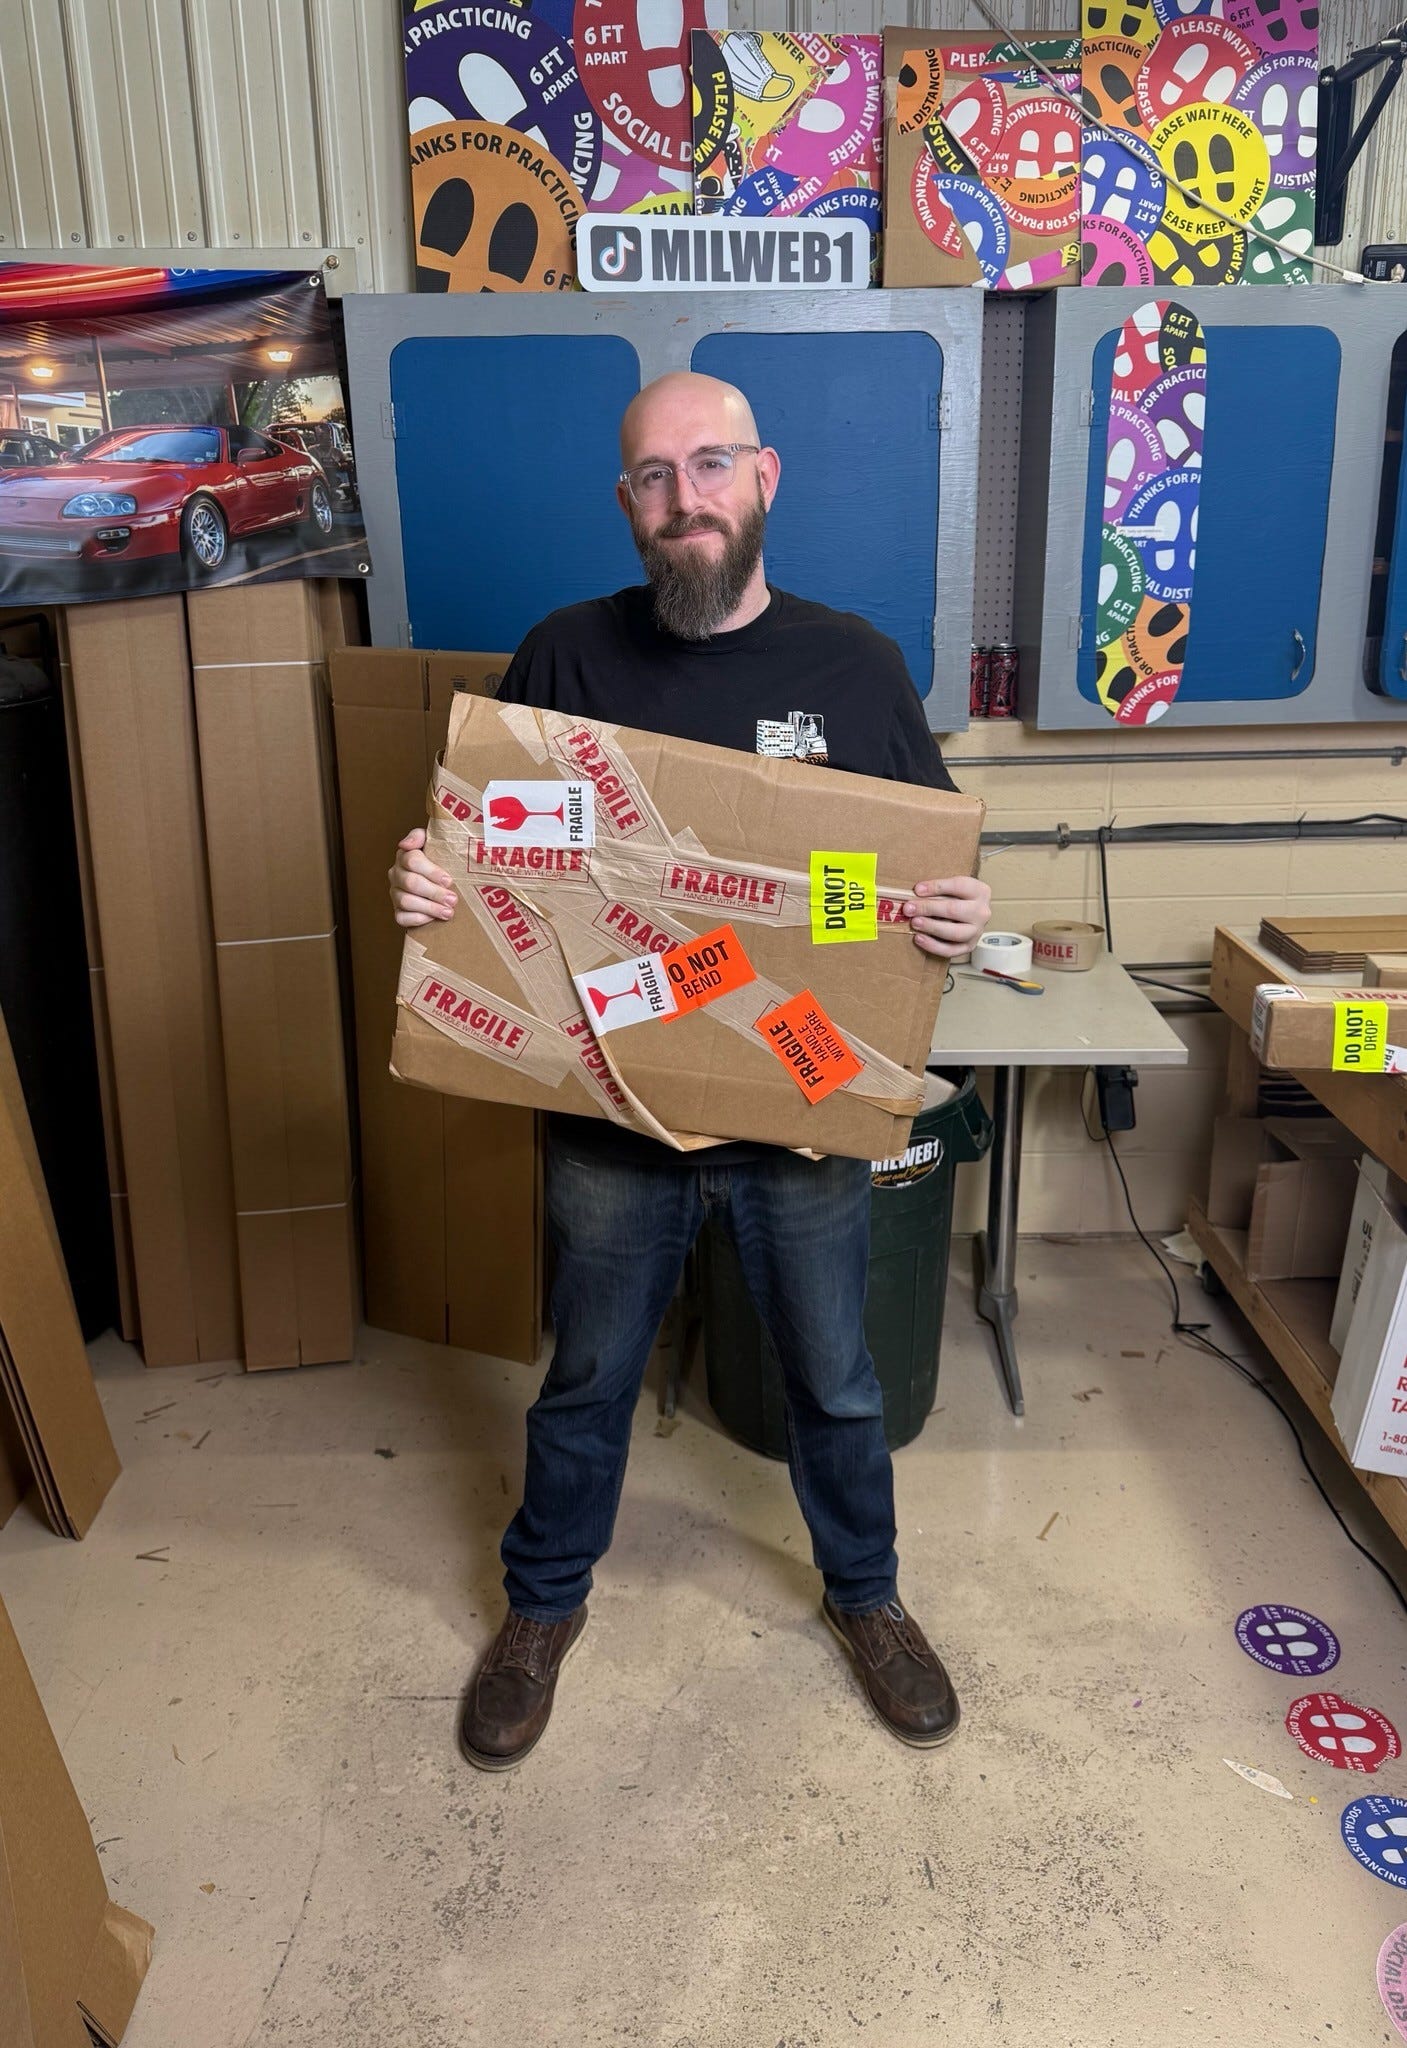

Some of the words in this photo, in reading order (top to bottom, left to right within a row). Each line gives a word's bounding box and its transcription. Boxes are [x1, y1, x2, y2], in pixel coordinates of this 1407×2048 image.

[408, 7, 532, 47] PRACTICING
[1237, 7, 1250, 19] FT
[584, 26, 597, 45] 6
[601, 24, 624, 44] FT
[1172, 21, 1222, 38] PLEASE
[1222, 27, 1251, 58] WAIT
[529, 66, 544, 85] 6
[539, 46, 564, 76] FT
[584, 51, 628, 66] APART
[541, 66, 578, 105] APART
[913, 48, 940, 125] DISTANCING
[1137, 66, 1153, 116] PLEASE
[1236, 62, 1272, 101] THANKS
[1272, 56, 1295, 70] FOR
[708, 71, 728, 139] PLEASE
[859, 85, 880, 132] WAIT
[602, 92, 673, 159] SOCIAL
[1185, 109, 1220, 123] WAIT
[1222, 112, 1253, 139] HERE
[462, 131, 503, 158] FOR
[827, 129, 866, 167] HERE
[978, 142, 991, 157] FT
[842, 194, 869, 208] FOR
[1240, 178, 1265, 219] APART
[953, 180, 974, 196] FOR
[974, 190, 1006, 255] PRACTICING
[1046, 217, 1071, 232] FOR
[1099, 220, 1119, 237] FOR
[1135, 209, 1148, 221] FT
[1196, 220, 1226, 235] KEEP
[651, 229, 853, 283] MILWEB1
[1163, 324, 1189, 339] APART
[1169, 312, 1178, 323] 6
[1177, 315, 1193, 328] FT
[1140, 389, 1158, 414] FOR
[1117, 407, 1162, 462] PRACTICING
[1129, 480, 1165, 519] THANKS
[1166, 473, 1188, 488] FOR
[1108, 528, 1142, 593] PRACTICING
[1106, 610, 1130, 625] APART
[1113, 599, 1122, 609] 6
[1120, 602, 1136, 615] FT
[1121, 682, 1156, 719] THANKS
[1156, 674, 1179, 689] FOR
[568, 731, 641, 831] FRAGILE
[568, 786, 583, 842] FRAGILE
[476, 841, 583, 872] FRAGILE
[670, 866, 778, 905] FRAGILE
[683, 892, 716, 903] HANDLE
[716, 896, 736, 907] WITH
[737, 900, 759, 910] CARE
[687, 940, 730, 972] NOT
[637, 960, 665, 1012] FRAGILE
[682, 970, 722, 999] BEND
[423, 981, 524, 1049] FRAGILE
[431, 1008, 462, 1028] HANDLE
[462, 1025, 481, 1038] WITH
[479, 1035, 500, 1048] CARE
[805, 1010, 827, 1036] CARE
[1346, 1007, 1364, 1038] NOT
[797, 1024, 829, 1062] HANDLE
[822, 1035, 845, 1062] WITH
[1364, 1019, 1378, 1051] DROP
[768, 1020, 825, 1088] FRAGILE
[1344, 1044, 1361, 1063] DO
[1282, 1607, 1317, 1625] THANKS
[1238, 1632, 1283, 1671] DISTANCING
[1345, 1806, 1362, 1834] SOCIAL
[1365, 1798, 1381, 1816] APART
[1378, 1804, 1391, 1814] FT
[1347, 1836, 1406, 1886] DISTANCING
